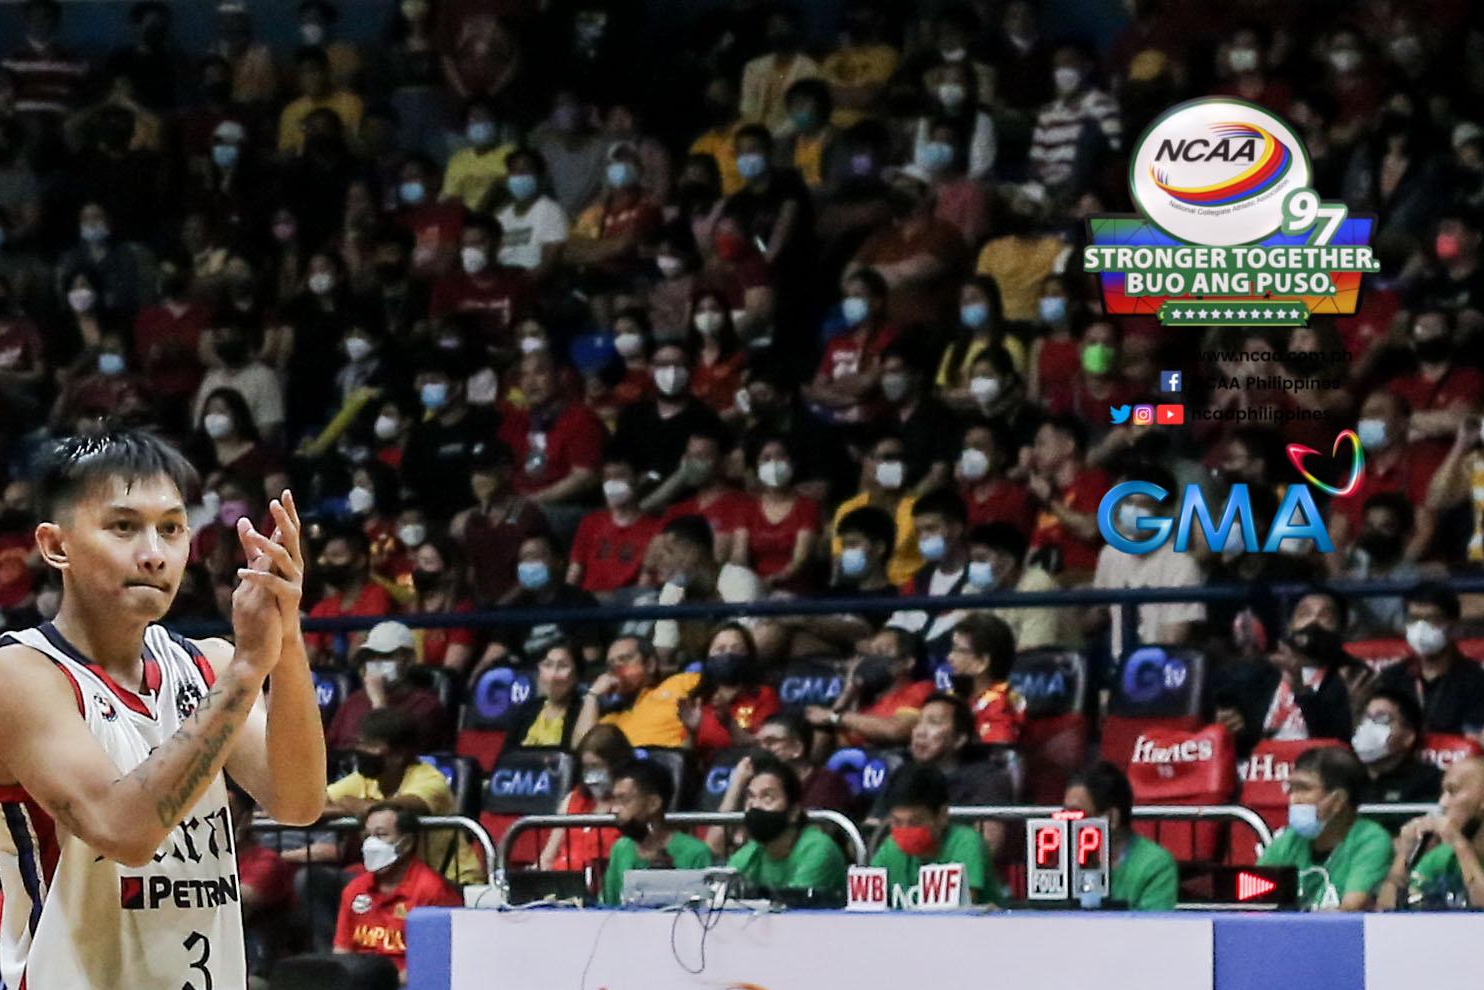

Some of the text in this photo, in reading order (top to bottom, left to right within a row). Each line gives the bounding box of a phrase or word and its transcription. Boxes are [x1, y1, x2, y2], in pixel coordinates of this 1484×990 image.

[780, 676, 841, 704] GMA
[491, 768, 551, 797] GMA
[148, 874, 239, 909] PETRN
[849, 875, 885, 902] WB
[923, 868, 960, 904] WF
